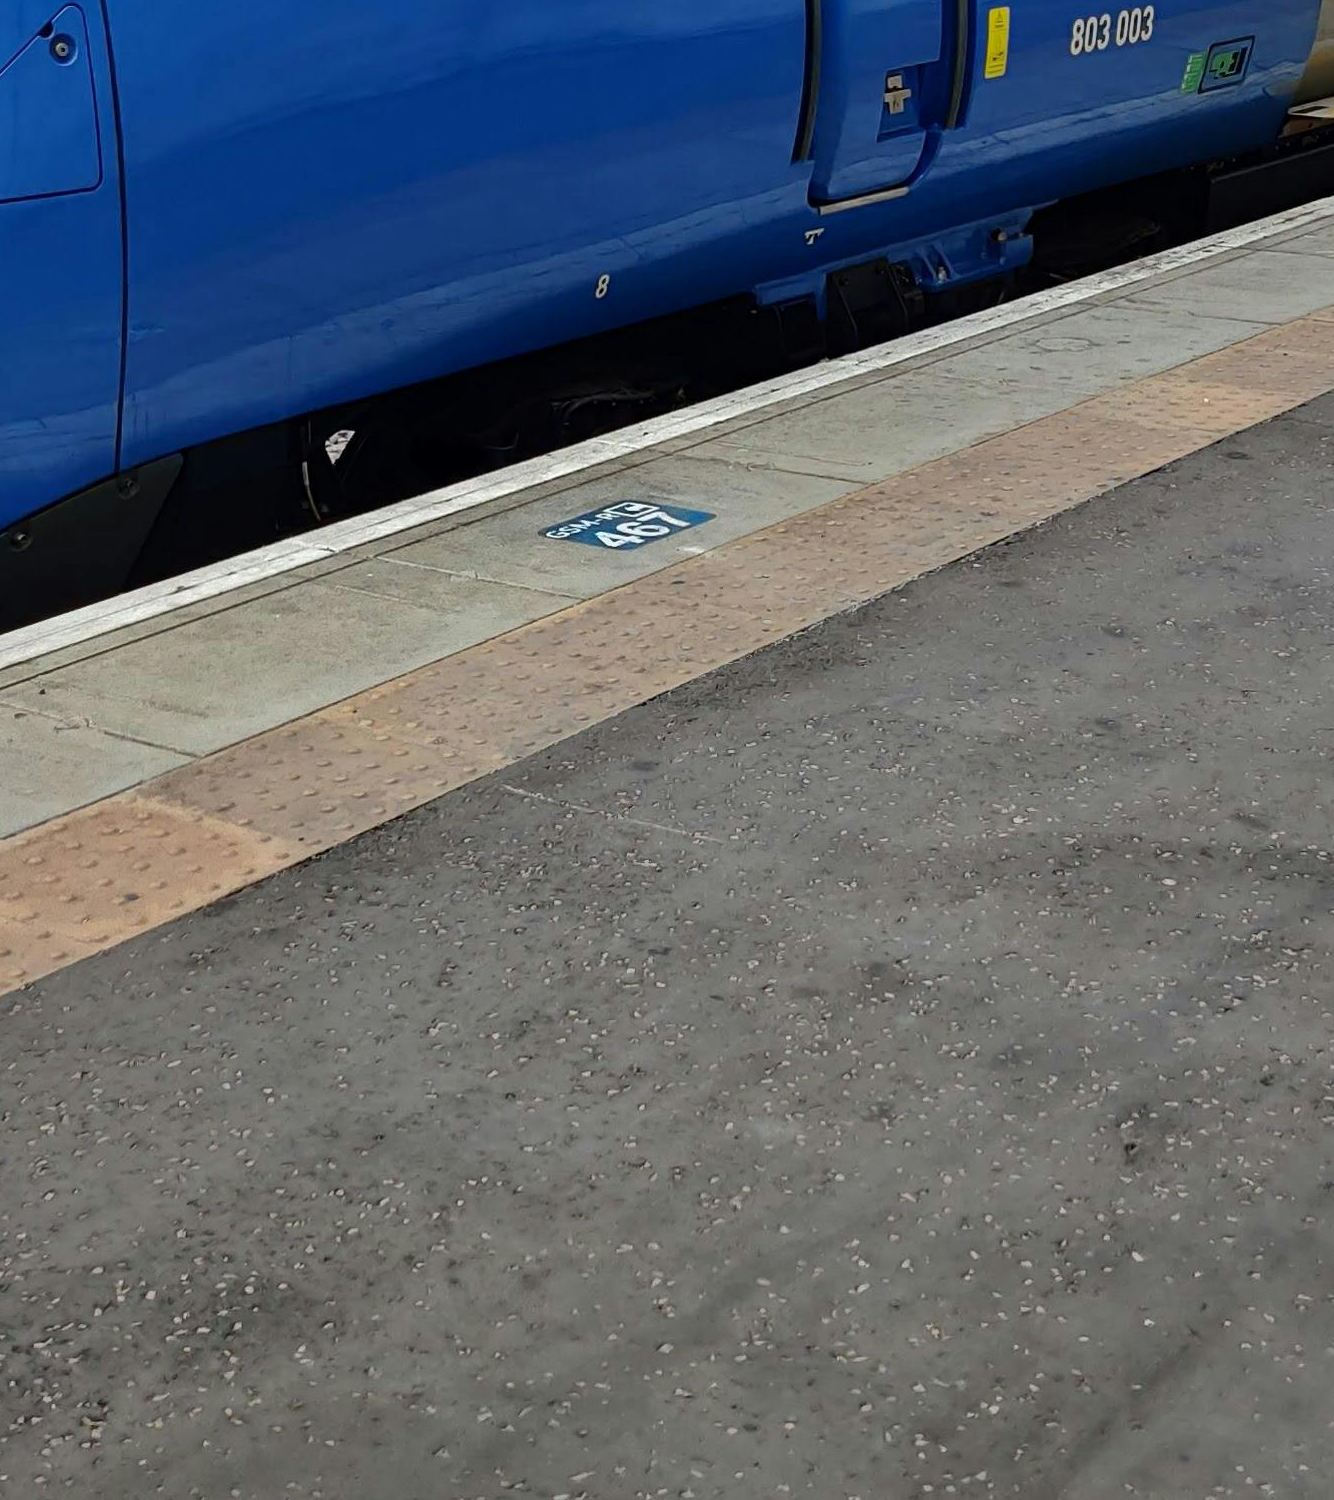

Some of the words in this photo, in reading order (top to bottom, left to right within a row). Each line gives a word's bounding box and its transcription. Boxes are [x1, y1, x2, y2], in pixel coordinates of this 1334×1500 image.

[1070, 13, 1111, 56] 803
[1115, 5, 1155, 47] 003
[595, 274, 610, 299] 8
[546, 512, 620, 540] GSM-R
[595, 511, 691, 548] 467
